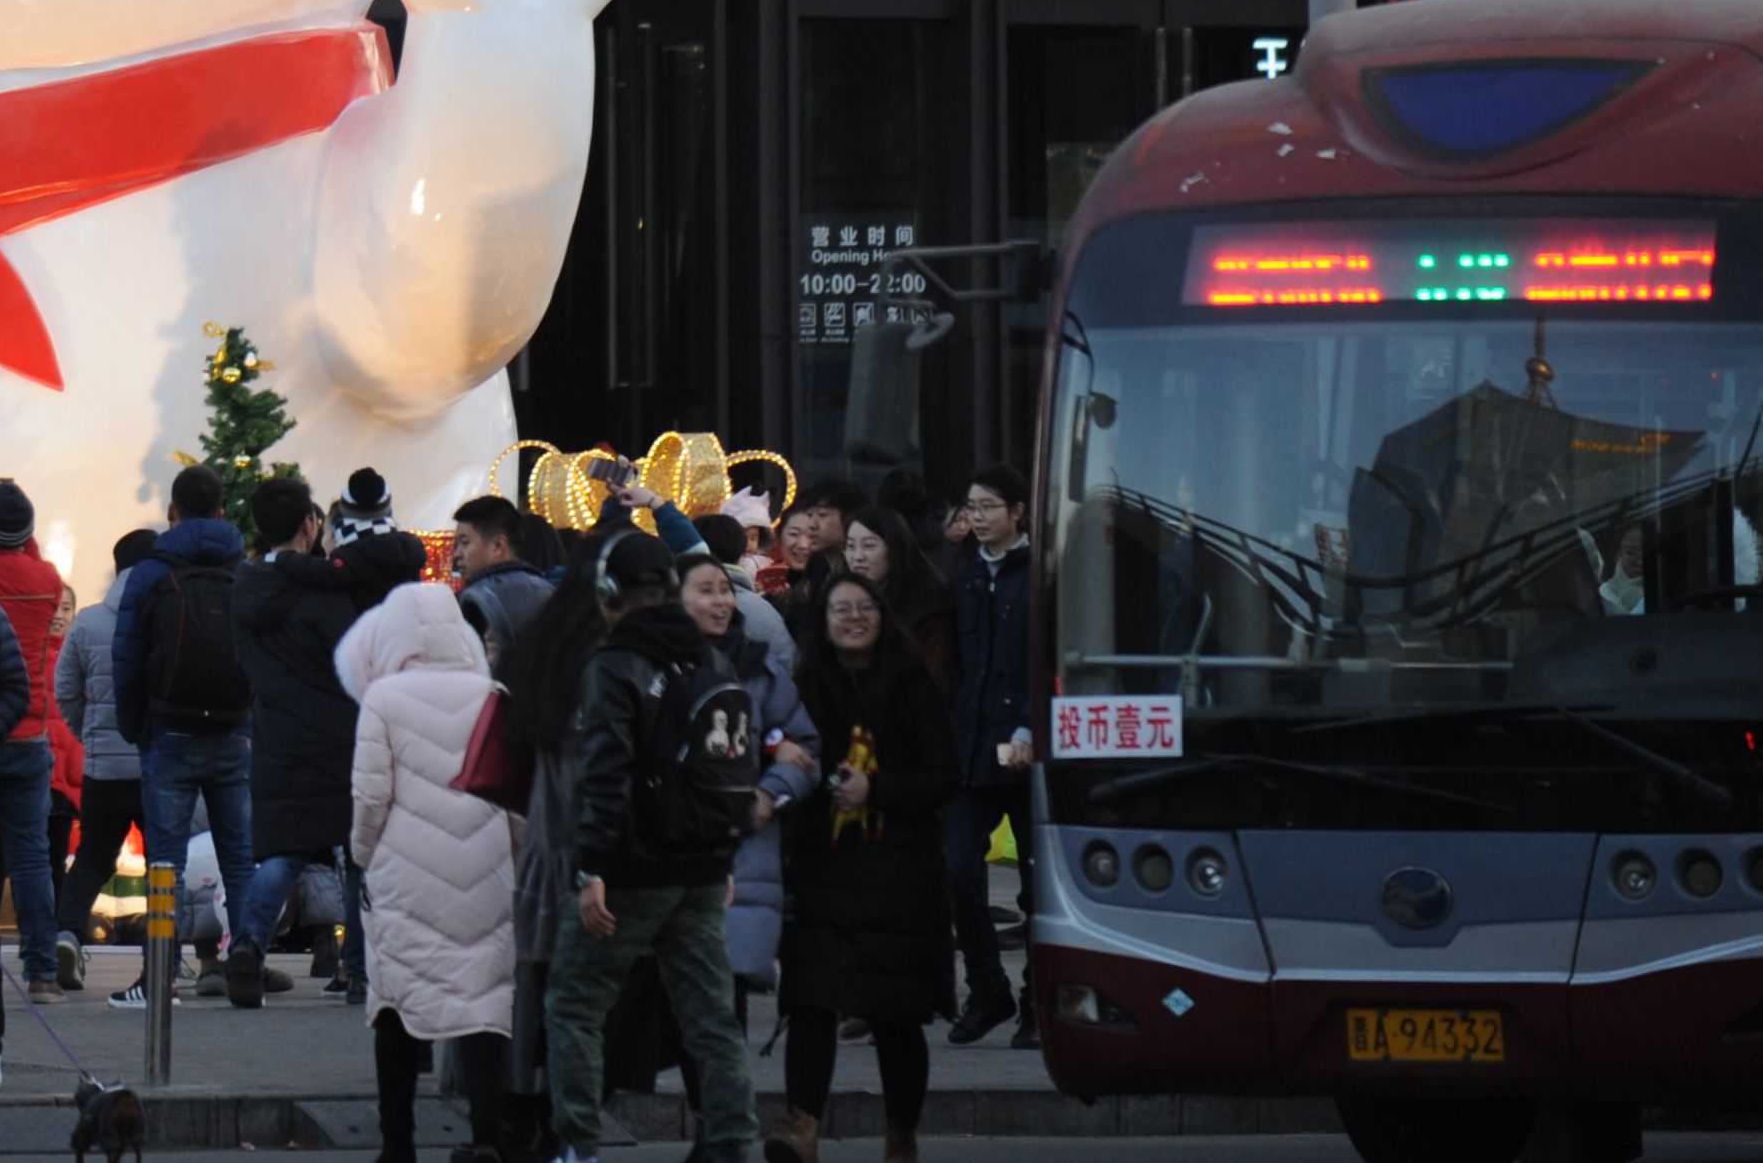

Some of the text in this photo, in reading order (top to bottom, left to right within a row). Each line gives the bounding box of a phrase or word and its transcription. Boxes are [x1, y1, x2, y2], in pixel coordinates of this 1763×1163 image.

[811, 225, 914, 247] 营业时间
[811, 249, 869, 265] Opening
[1058, 704, 1174, 750] 投币壹元
